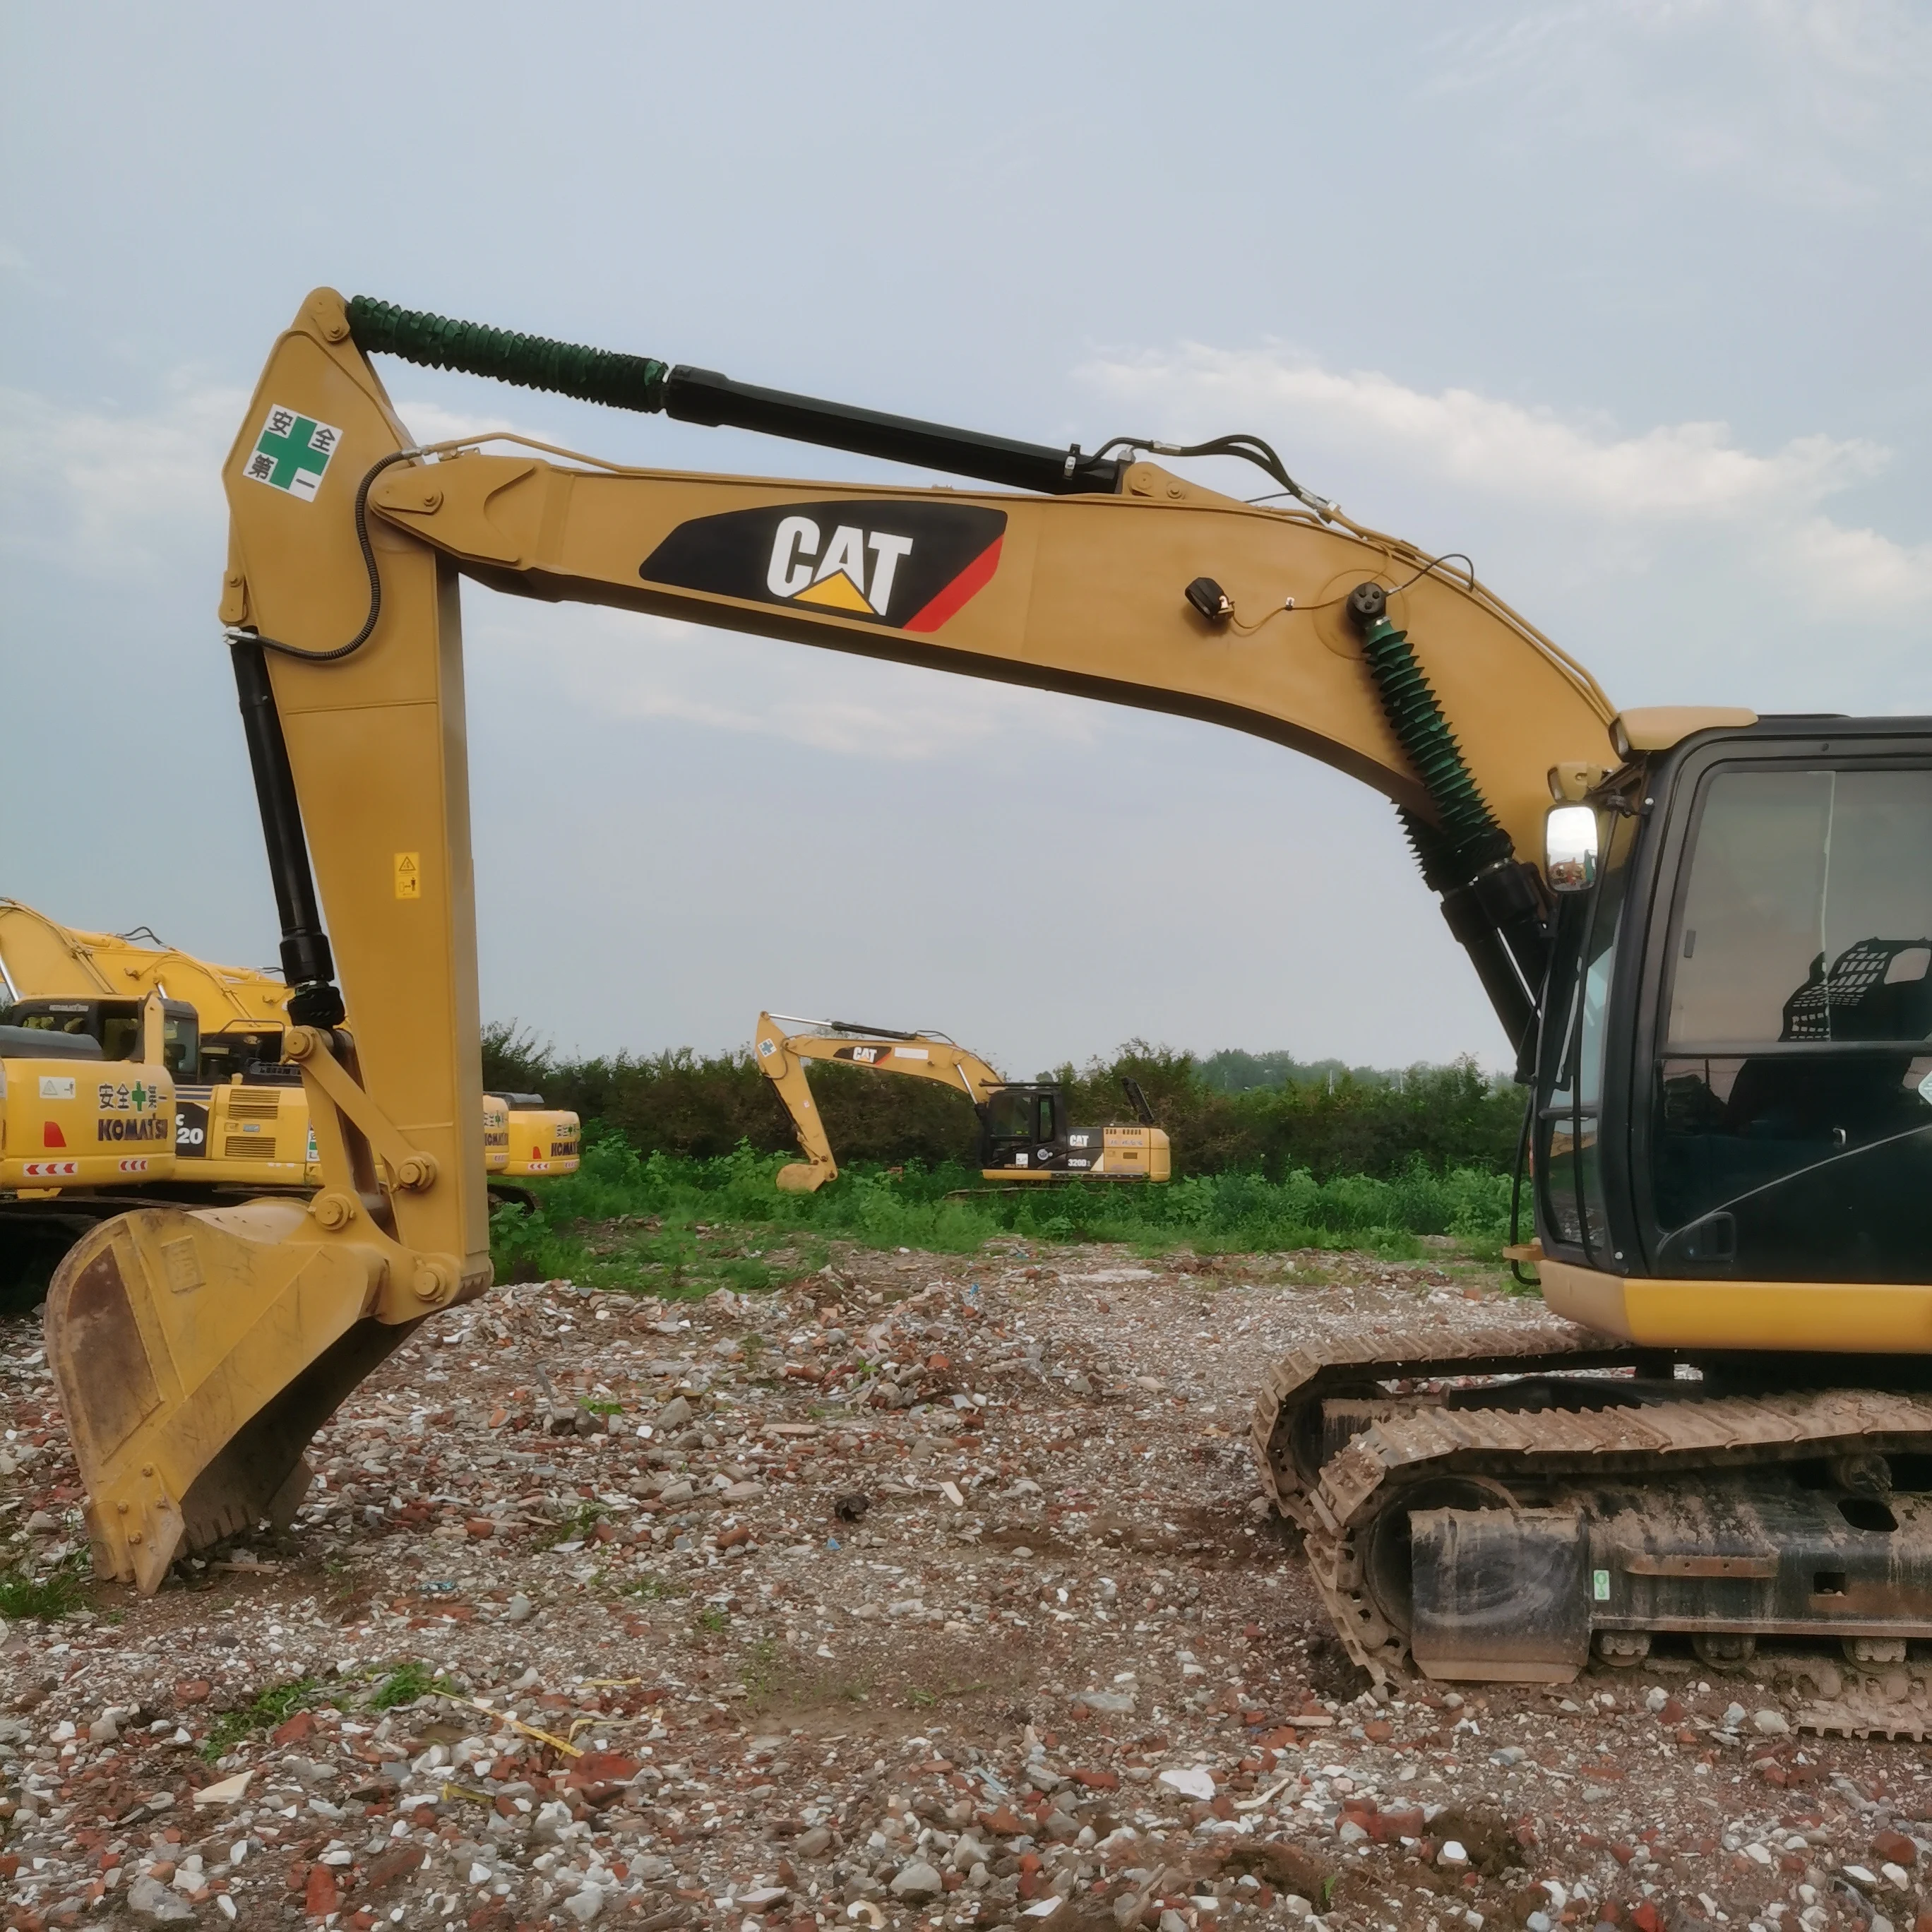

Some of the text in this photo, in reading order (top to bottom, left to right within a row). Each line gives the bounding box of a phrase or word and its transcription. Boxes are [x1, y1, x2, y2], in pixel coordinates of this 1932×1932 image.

[268, 411, 335, 452] 安全
[248, 454, 316, 489] 第一
[767, 515, 914, 616] CAT
[852, 1046, 878, 1063] CAT
[99, 1083, 130, 1109] 安全
[176, 1128, 204, 1145] 20
[1069, 1134, 1090, 1147] CAT
